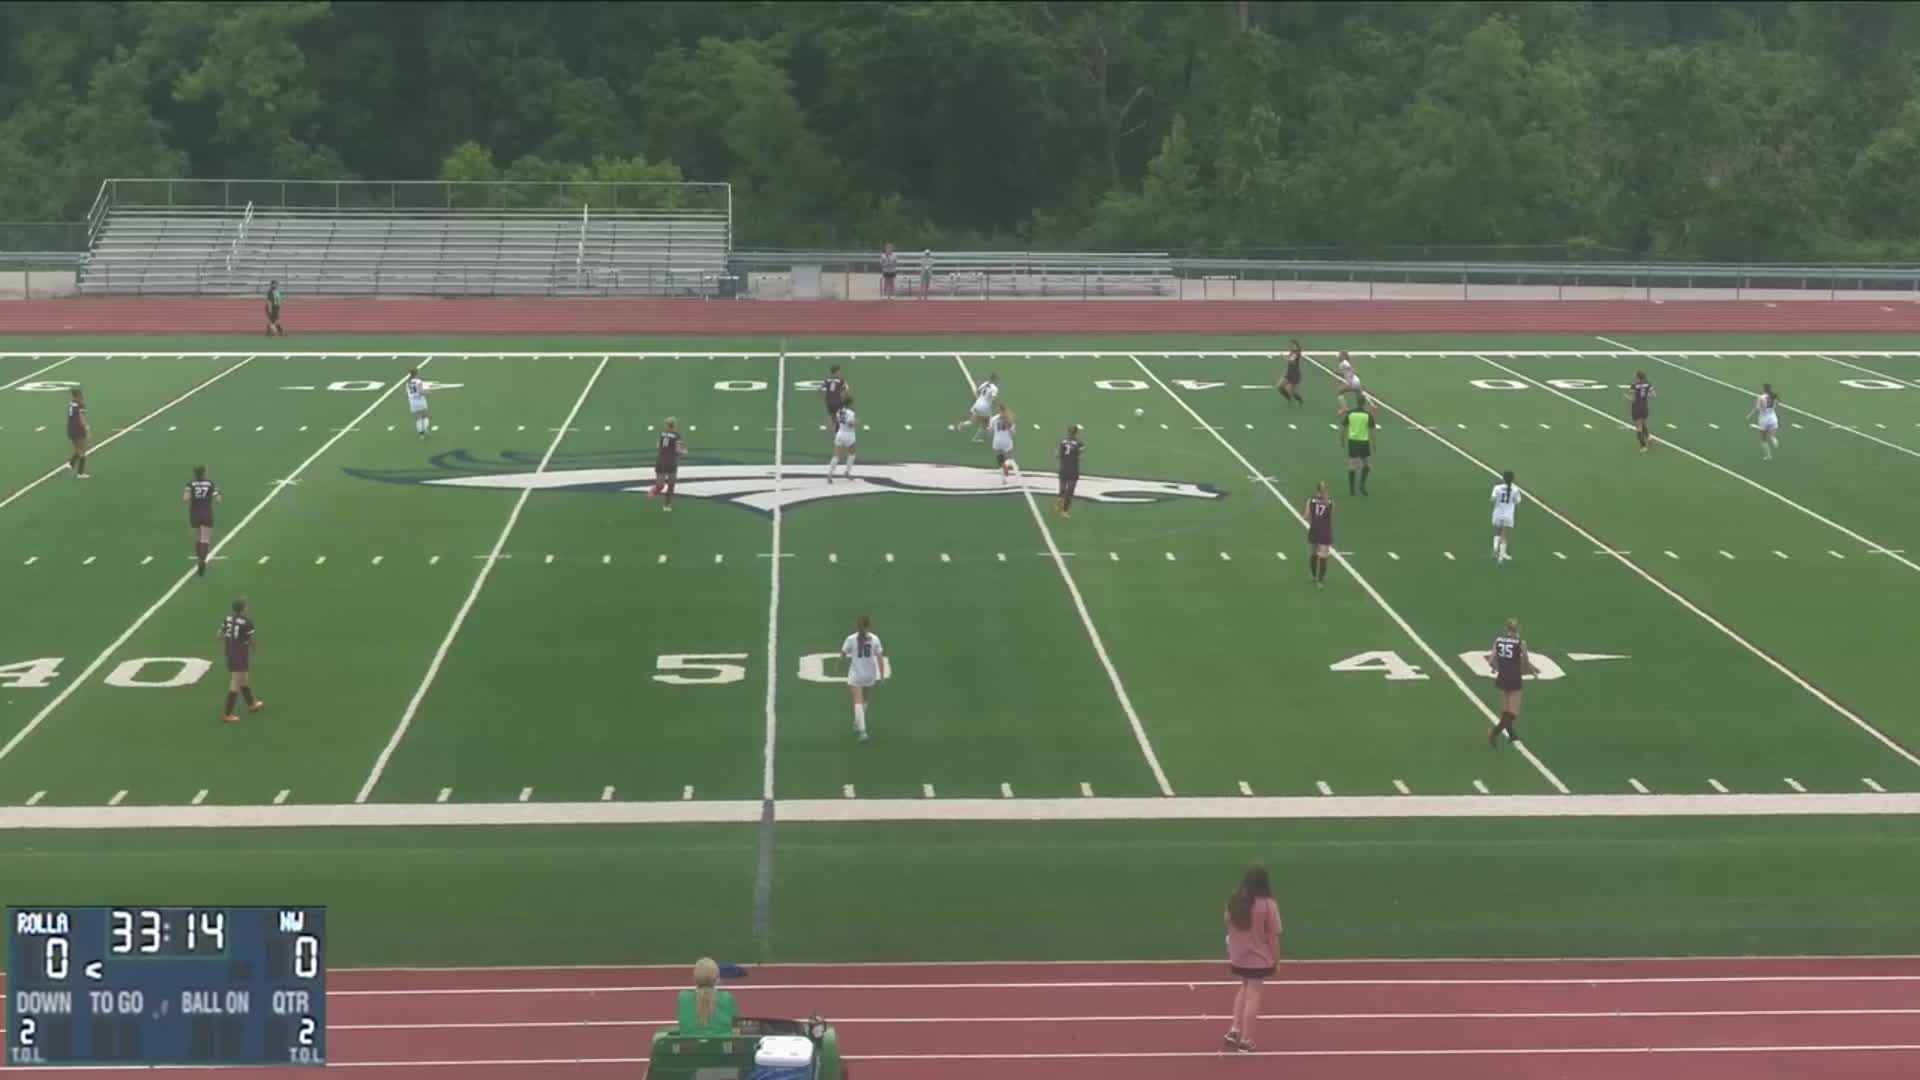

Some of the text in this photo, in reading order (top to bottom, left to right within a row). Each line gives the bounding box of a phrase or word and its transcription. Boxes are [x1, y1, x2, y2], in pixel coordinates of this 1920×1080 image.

[194, 487, 208, 499] 27
[1315, 503, 1326, 516] 17
[1498, 643, 1513, 658] 35
